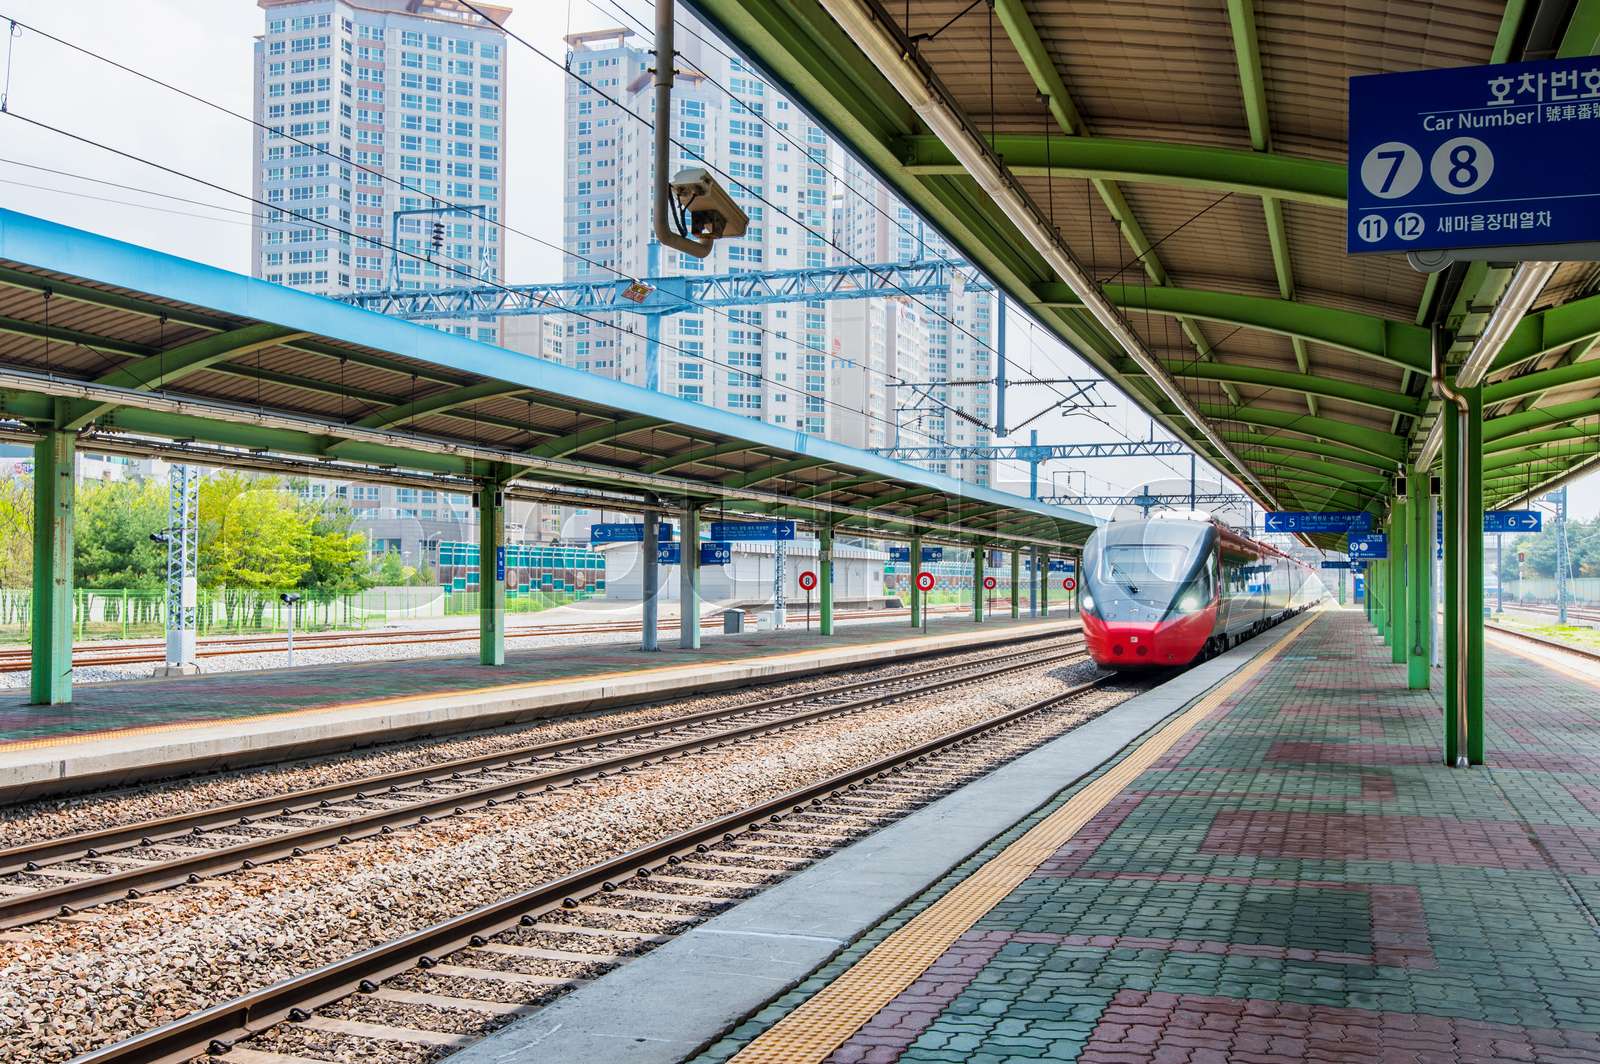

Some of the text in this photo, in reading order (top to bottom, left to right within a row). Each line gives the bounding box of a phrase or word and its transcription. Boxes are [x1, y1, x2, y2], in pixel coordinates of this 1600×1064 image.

[1423, 109, 1534, 132] Car Number
[1437, 210, 1552, 233] 새마을장대열차
[1288, 518, 1296, 528] 5
[1507, 516, 1516, 527] 6
[606, 529, 612, 537] 3
